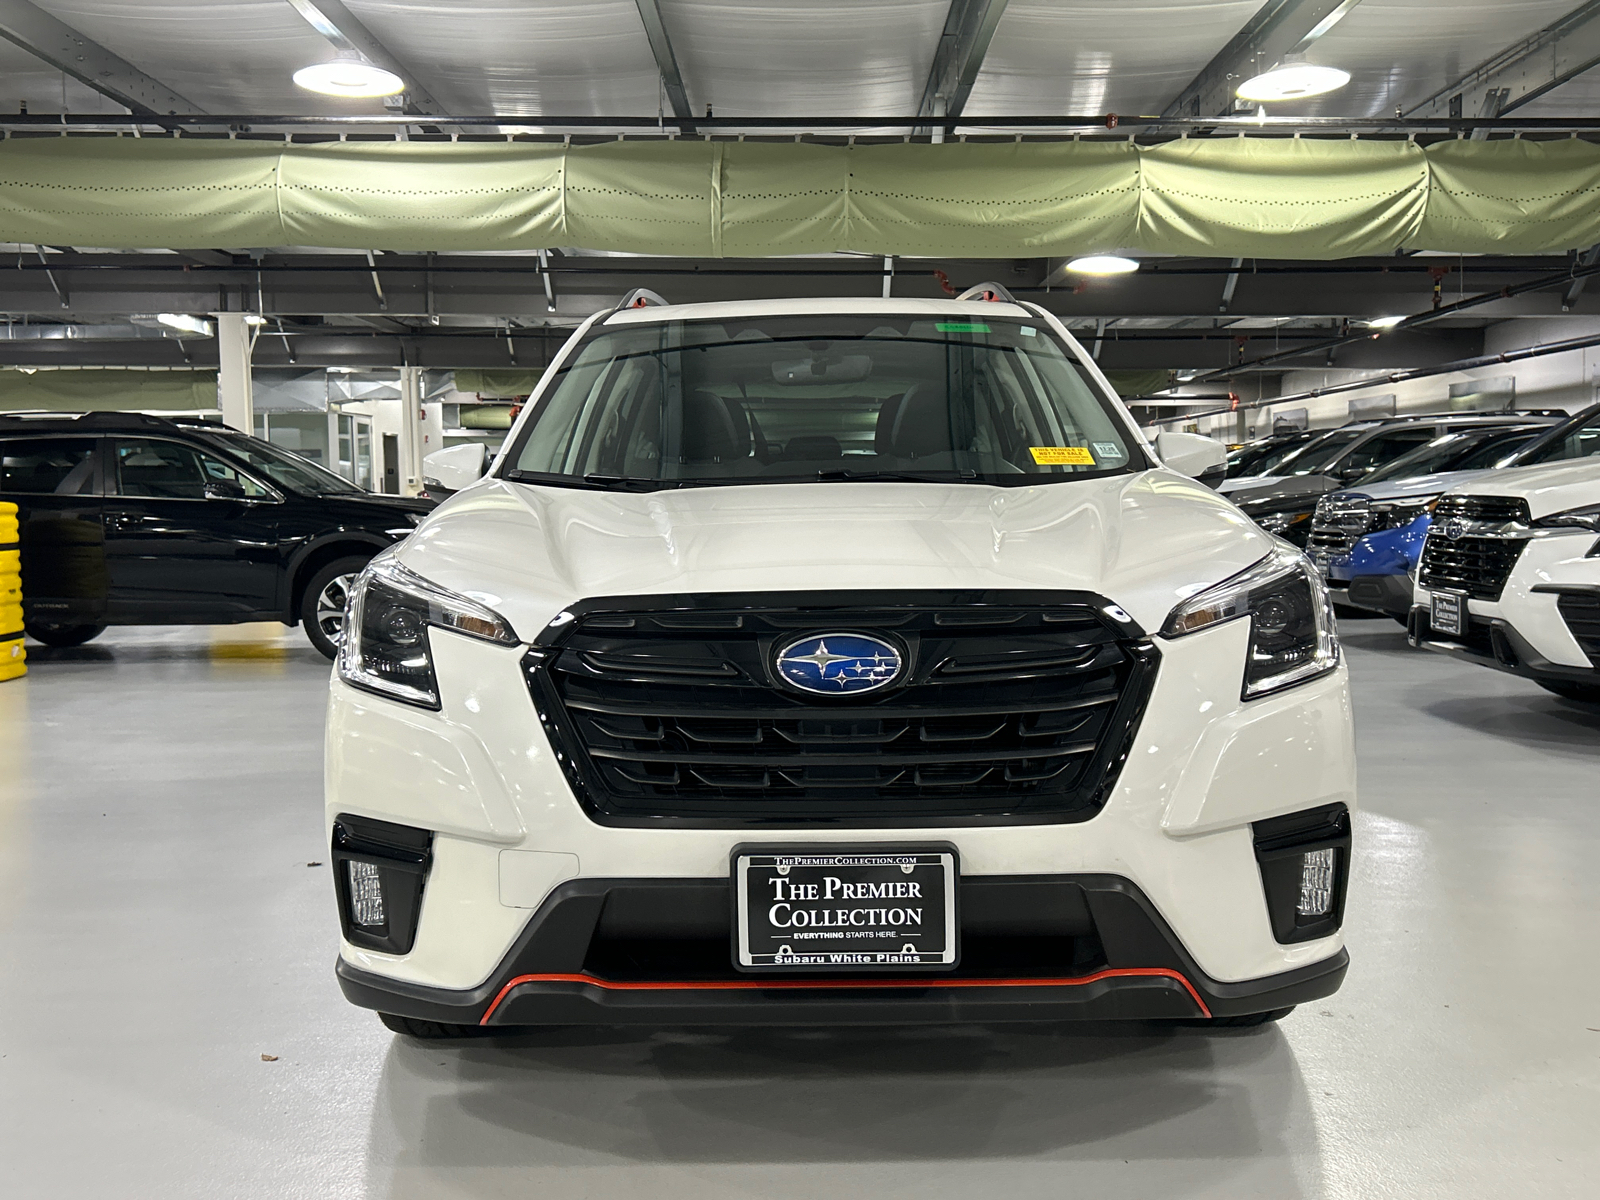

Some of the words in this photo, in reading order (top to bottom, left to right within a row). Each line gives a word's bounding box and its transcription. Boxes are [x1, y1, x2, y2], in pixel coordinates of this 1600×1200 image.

[768, 877, 819, 901] THE
[823, 877, 922, 900] PREMIER
[768, 903, 923, 928] COLLECTION
[793, 932, 845, 940] EVERYTHING
[845, 931, 874, 939] STARTS
[774, 954, 825, 964] Subaru
[829, 954, 872, 963] White
[876, 954, 921, 963] Plains
